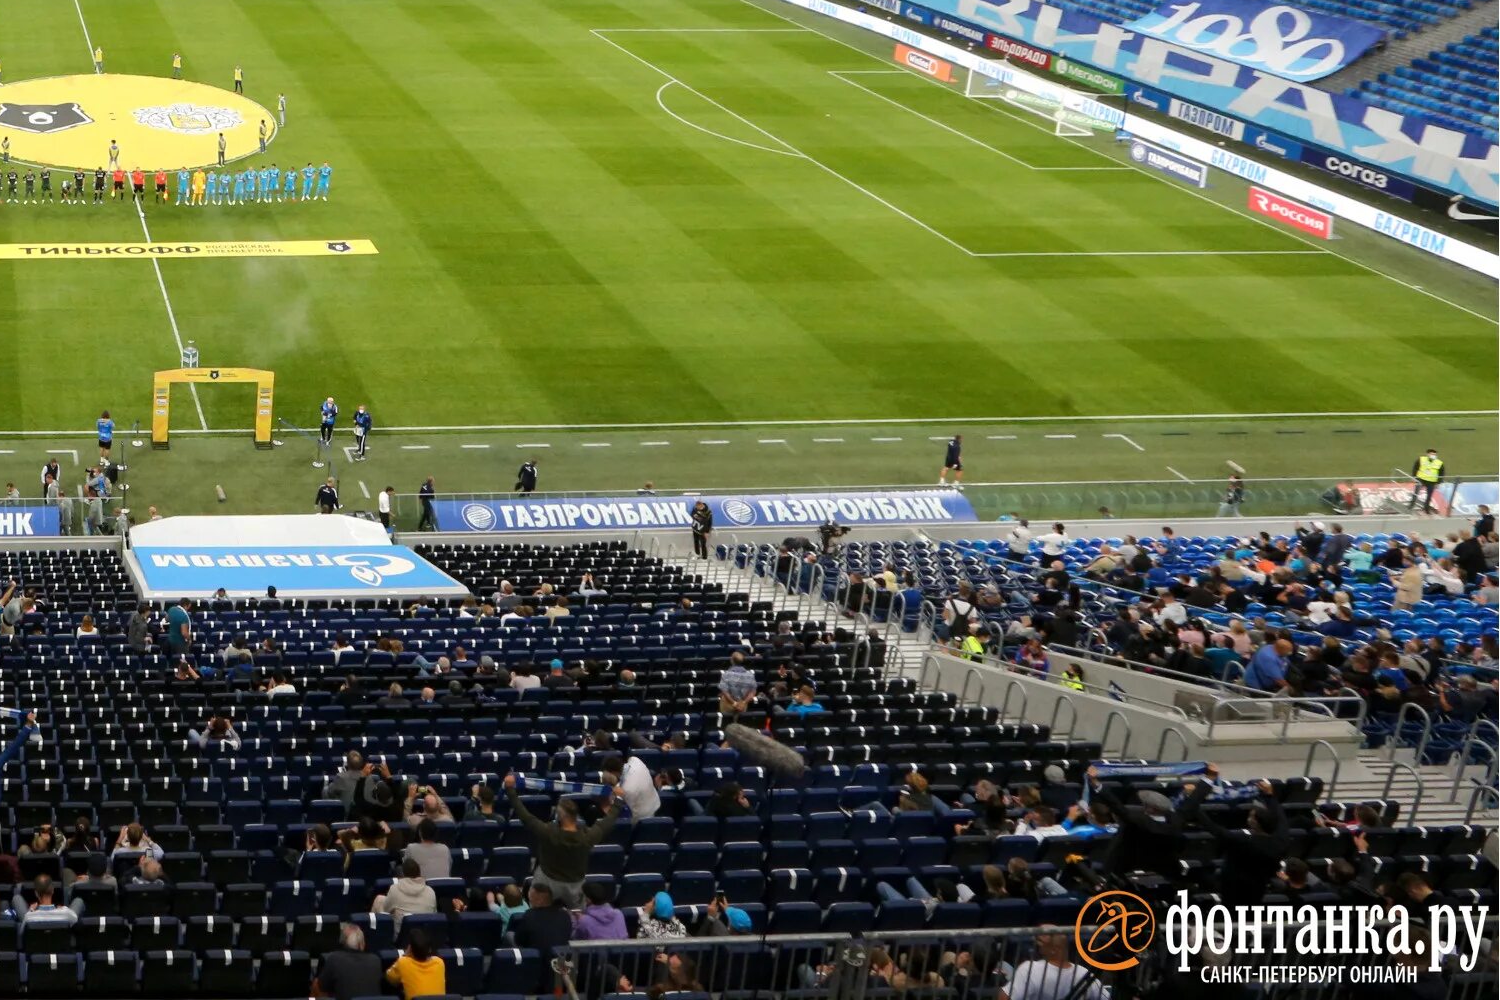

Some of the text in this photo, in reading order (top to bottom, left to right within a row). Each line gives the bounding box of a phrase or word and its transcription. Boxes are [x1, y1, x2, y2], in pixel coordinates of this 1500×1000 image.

[991, 34, 1047, 66] ЭЛЬДОРАДО
[1145, 0, 1345, 78] 1080
[1178, 103, 1235, 136] ГАЗПРОМ
[1211, 149, 1268, 183] GAZPROM
[1271, 203, 1326, 231] РОССИЯ
[1374, 212, 1447, 255] GAZPROM
[18, 245, 201, 255] ТИНЬКОФФ
[500, 502, 694, 529] ГАЗПРОМБАНК
[760, 498, 953, 523] ГАЗПРОМБАНК
[151, 553, 335, 567] ГАЗПРОМ
